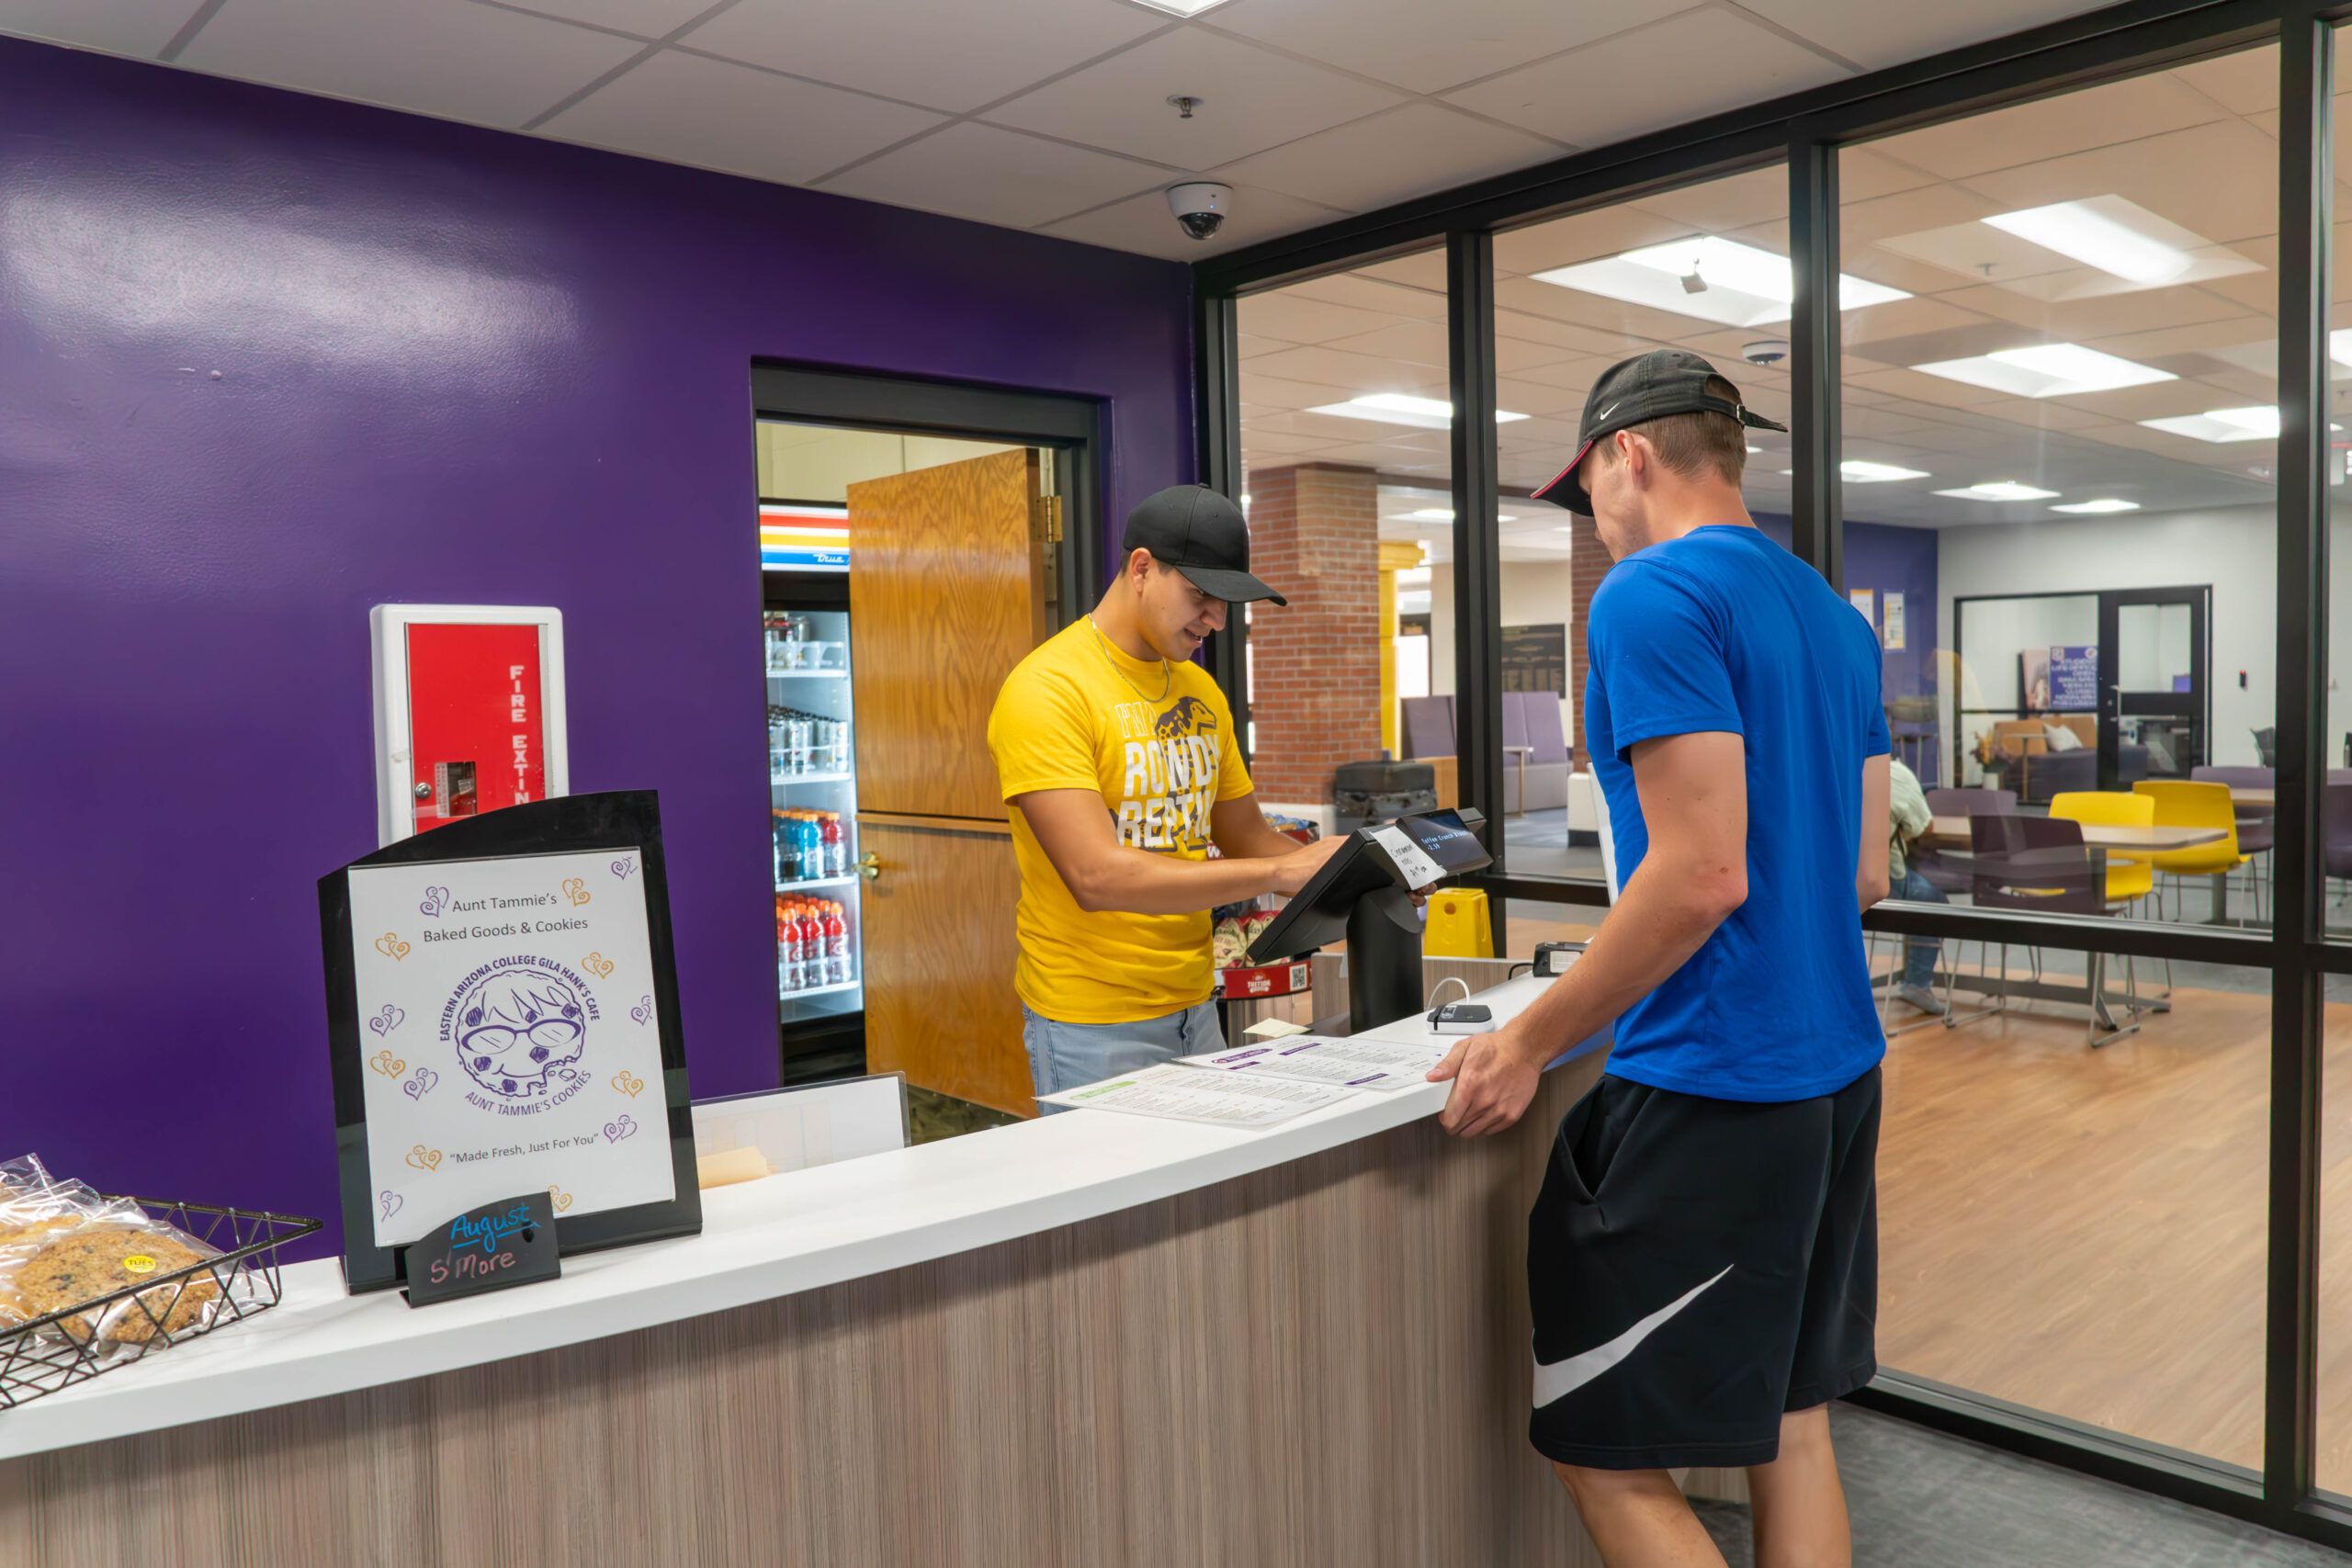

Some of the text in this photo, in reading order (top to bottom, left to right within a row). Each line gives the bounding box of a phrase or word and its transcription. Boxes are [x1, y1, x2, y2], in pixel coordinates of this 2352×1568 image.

[509, 665, 526, 722] FIRE
[512, 735, 529, 805] EXTIN
[1124, 734, 1220, 797] ROWDY
[452, 893, 557, 912] Aunt Tammie's
[424, 918, 588, 942] Baked Goods & Cookies
[440, 955, 600, 1042] EASTERN ARIZONA COLLEGE GILA HANK'S CAFE
[465, 1070, 593, 1117] AUNT TAMMIE'S COOKIES
[492, 1145, 526, 1158] Fresh,
[528, 1142, 549, 1153] Just
[552, 1139, 571, 1149] For
[450, 1202, 530, 1253] August
